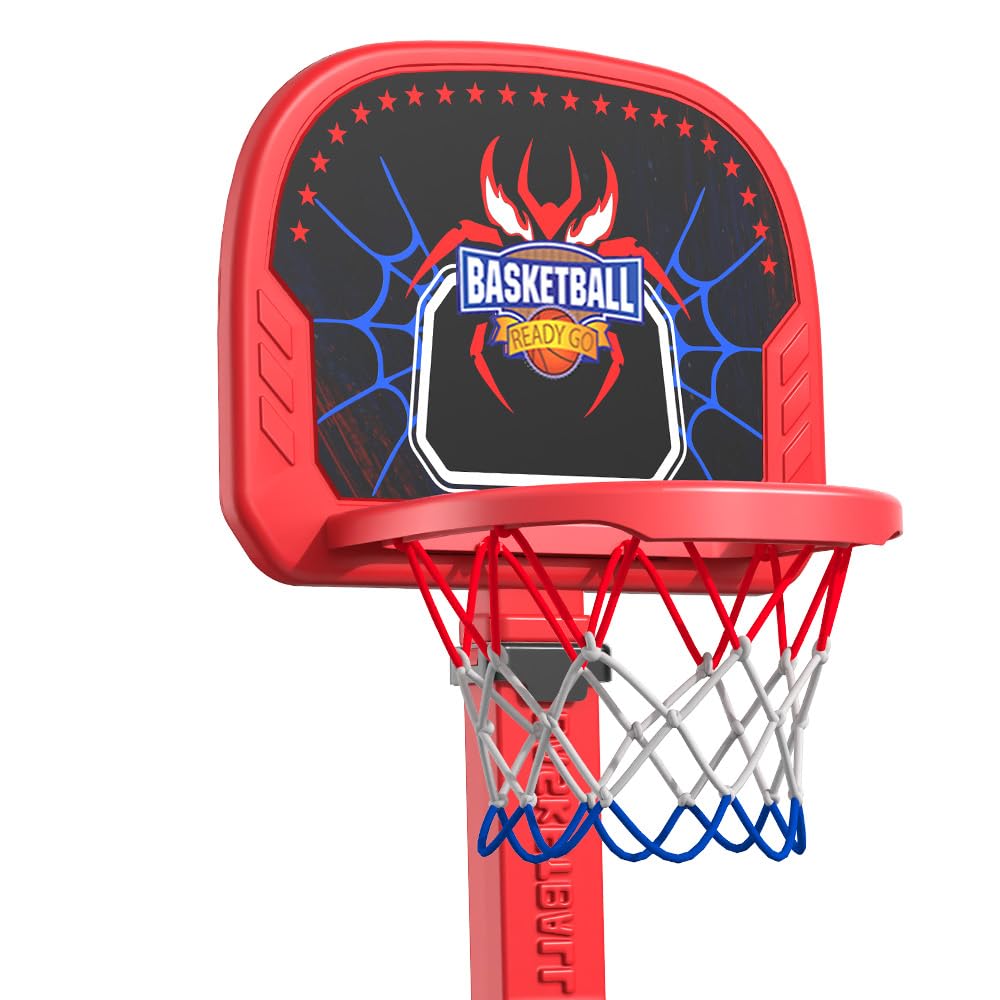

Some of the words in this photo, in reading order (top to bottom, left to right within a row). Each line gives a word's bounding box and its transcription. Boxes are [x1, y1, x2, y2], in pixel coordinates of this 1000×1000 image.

[466, 256, 635, 314] BASKETBALL
[511, 323, 565, 349] READY
[568, 329, 595, 353] GO
